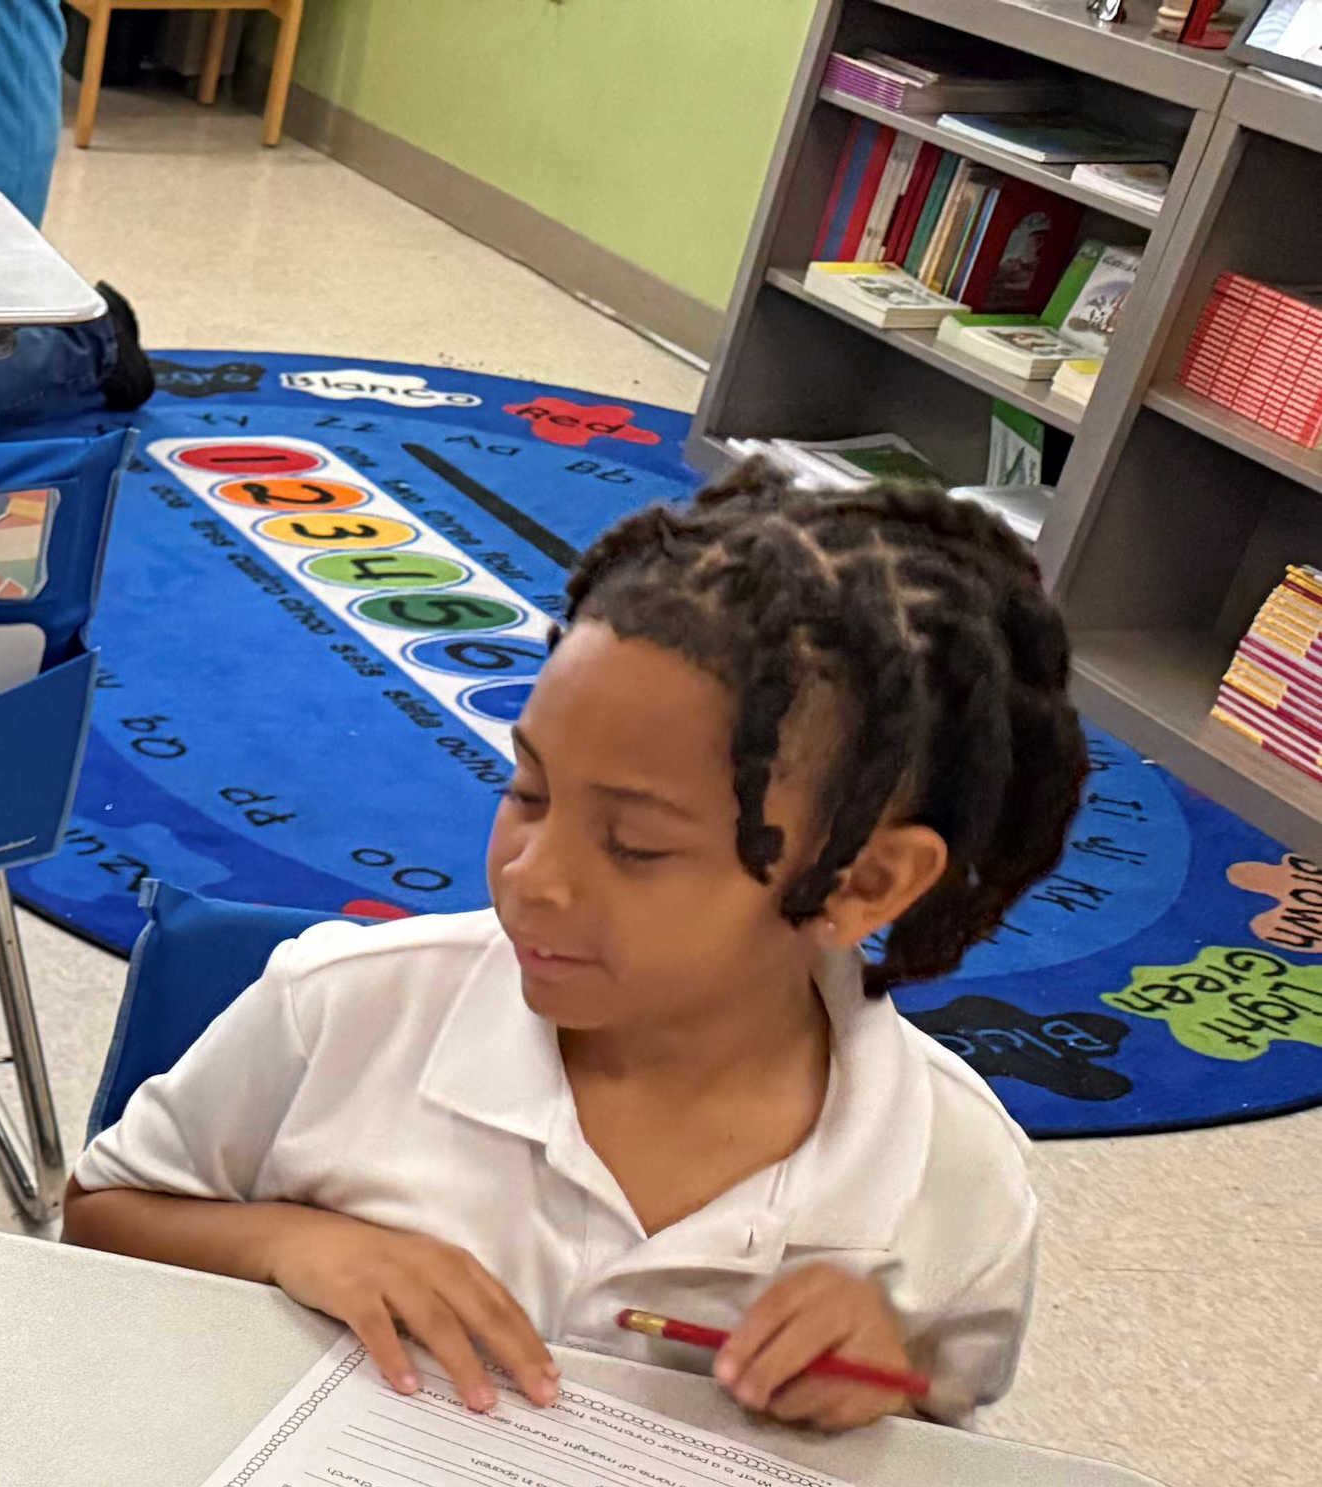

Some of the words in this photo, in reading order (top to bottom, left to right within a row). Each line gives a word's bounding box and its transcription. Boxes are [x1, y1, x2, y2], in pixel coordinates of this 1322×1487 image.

[285, 374, 475, 405] Blanco
[516, 407, 625, 434] Red
[242, 482, 336, 506] 2
[290, 522, 378, 541] 3
[351, 556, 436, 581] 4
[389, 599, 493, 628] 5
[445, 642, 545, 670] 6
[120, 715, 187, 758] Qq
[219, 786, 296, 826] Pp
[1032, 873, 1113, 913] Kk
[1112, 951, 1287, 1012] Green
[1200, 981, 1322, 1050] Light
